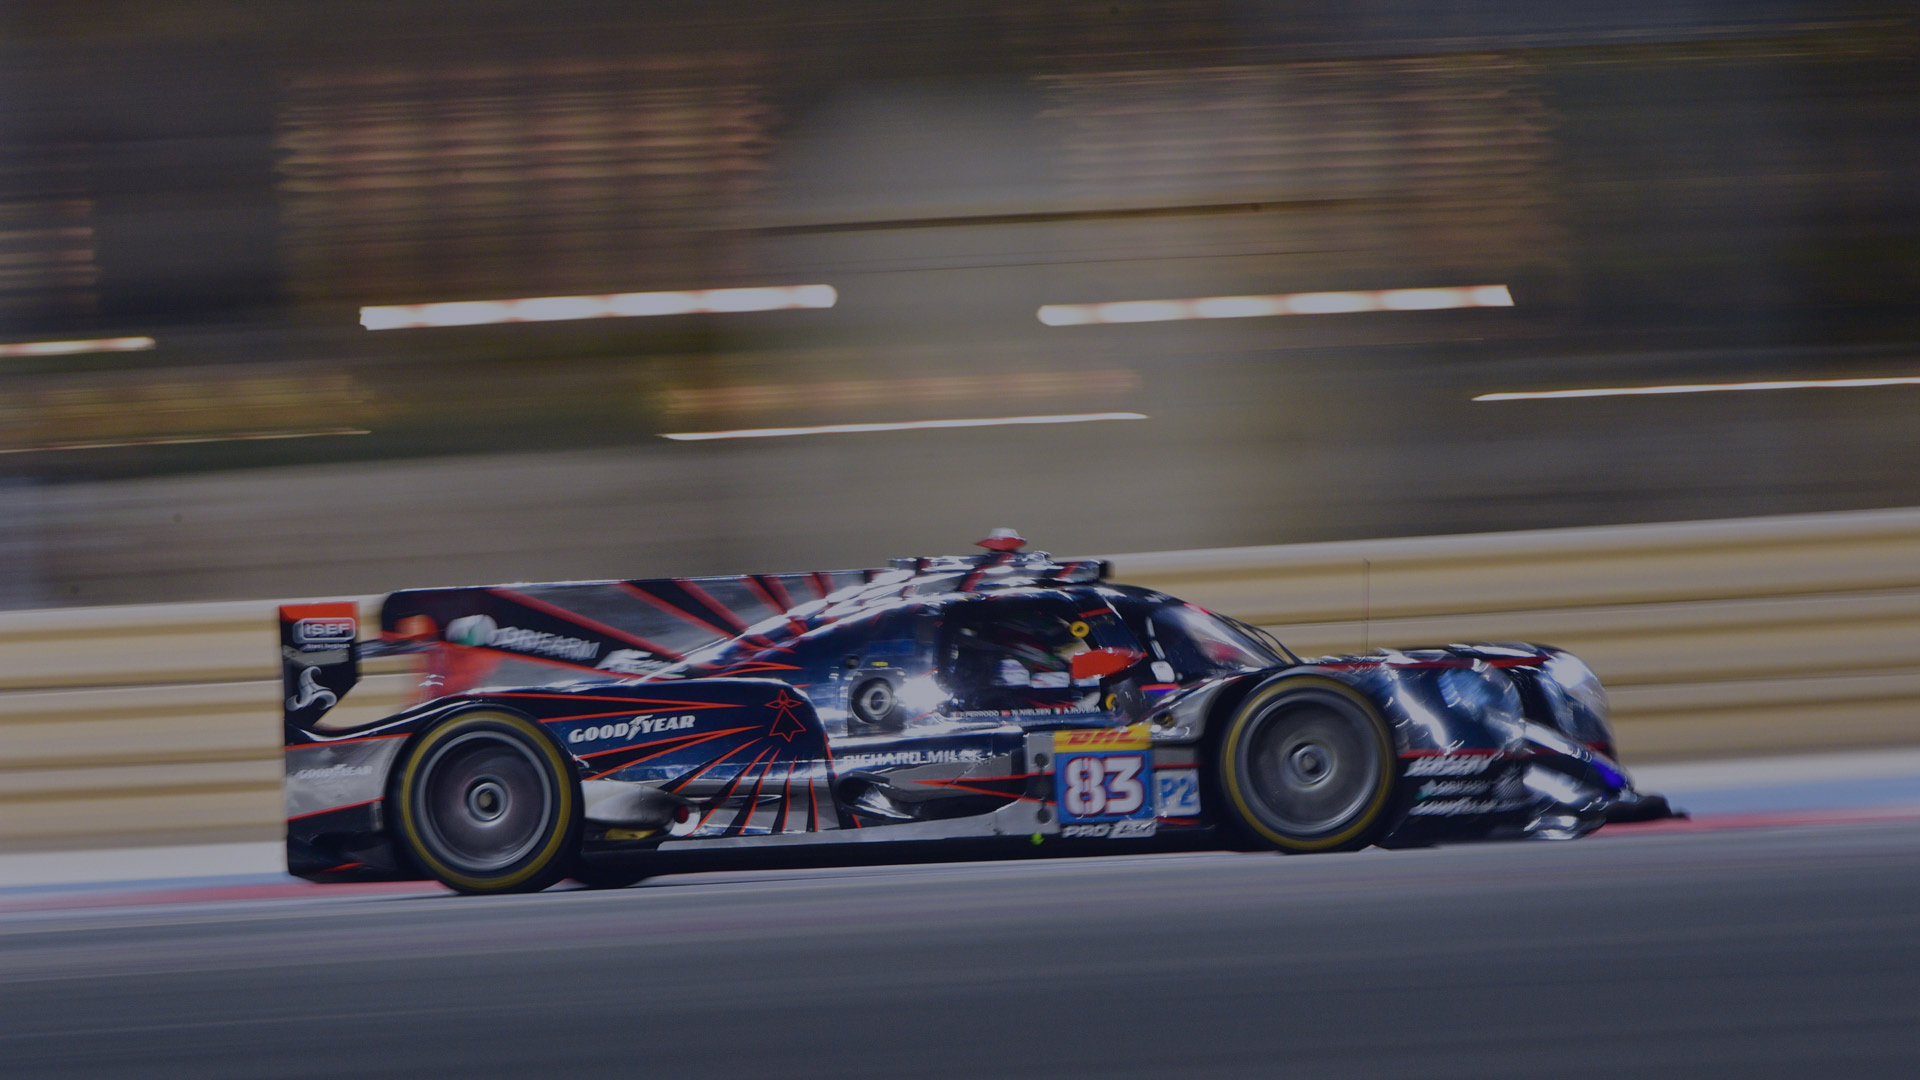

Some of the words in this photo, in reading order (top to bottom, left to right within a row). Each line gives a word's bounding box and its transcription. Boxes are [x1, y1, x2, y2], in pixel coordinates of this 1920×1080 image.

[567, 714, 696, 744] GOODYEAR
[1067, 730, 1138, 745] DHL
[1064, 756, 1144, 817] 83
[1160, 776, 1197, 808] P2
